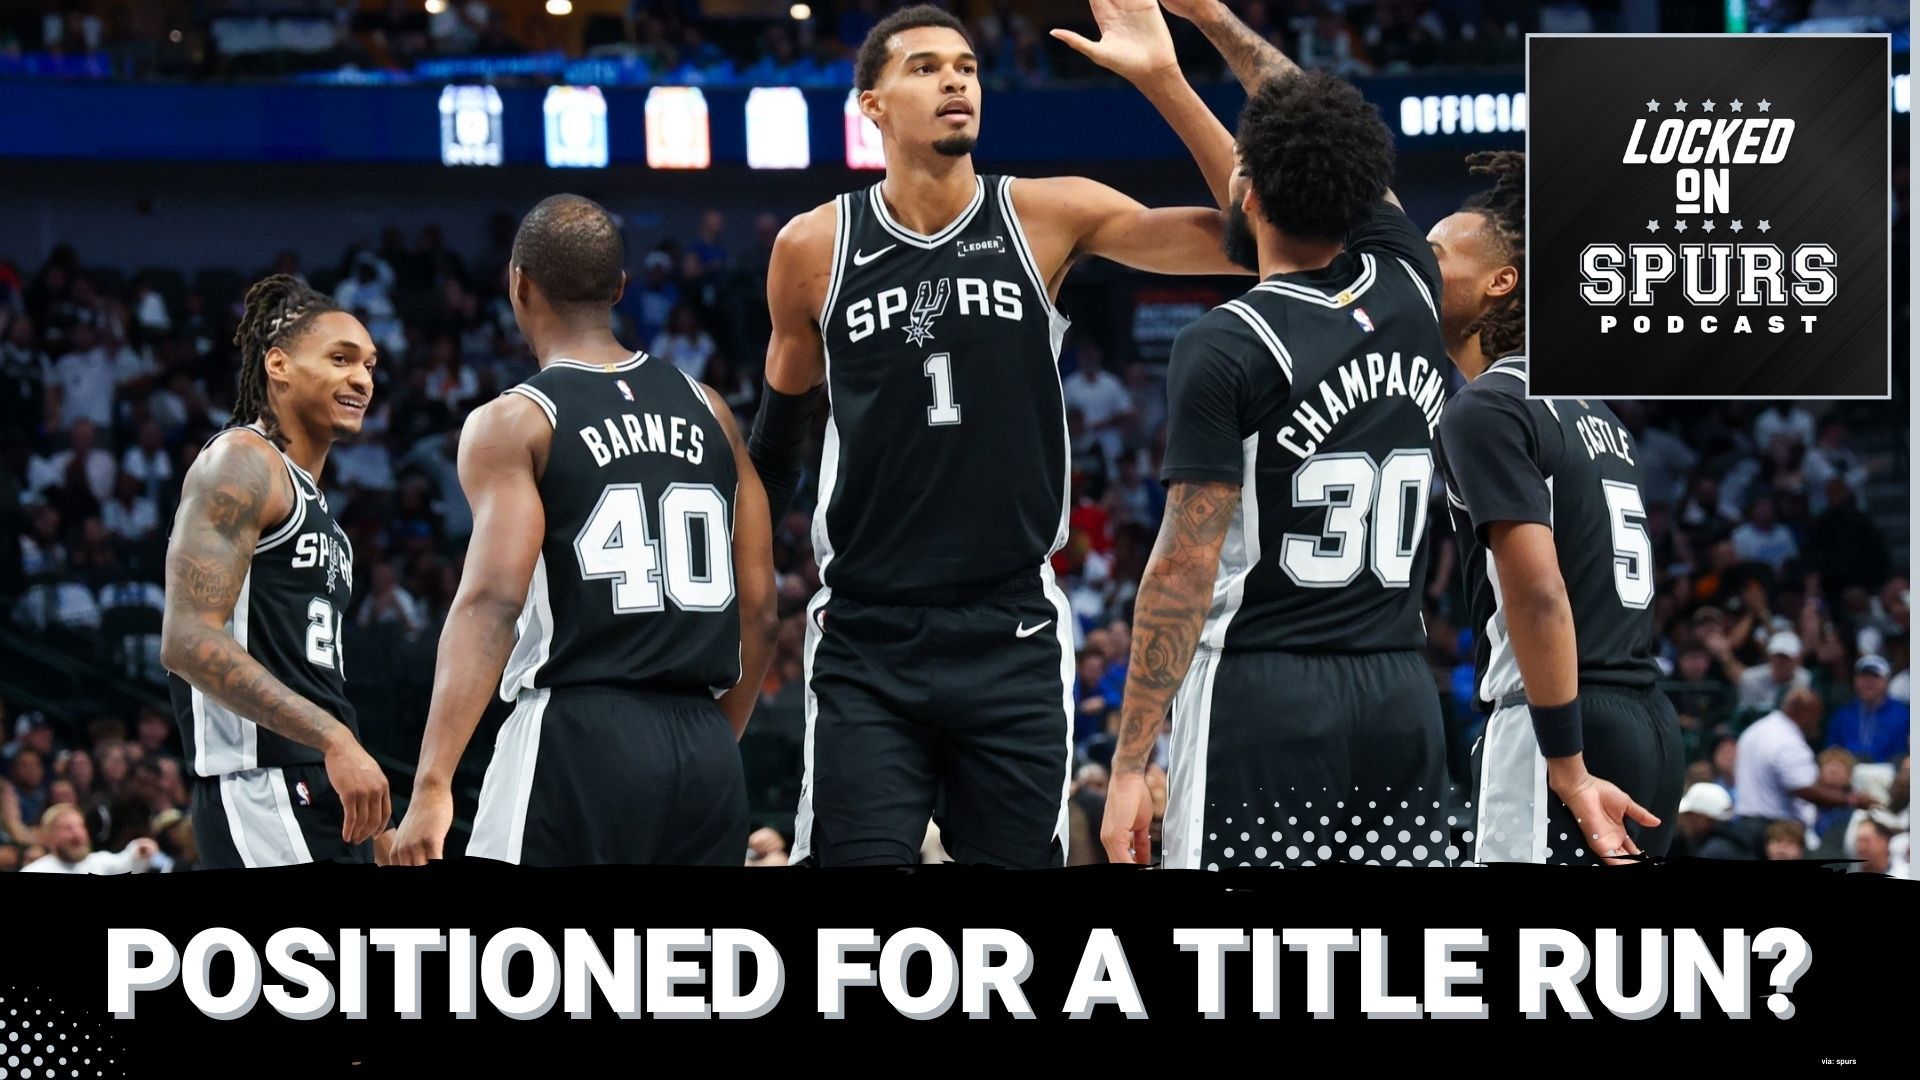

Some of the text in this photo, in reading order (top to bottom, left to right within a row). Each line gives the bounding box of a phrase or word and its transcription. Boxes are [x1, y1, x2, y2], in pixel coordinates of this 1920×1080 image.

[962, 240, 999, 252] LEDGER
[846, 277, 1023, 348] SPURS
[923, 352, 961, 426] 1
[579, 412, 704, 468] BARNES
[1576, 414, 1634, 466] CASTLE
[572, 481, 736, 615] 40
[1279, 448, 1435, 588] 30
[1601, 478, 1655, 610] 5
